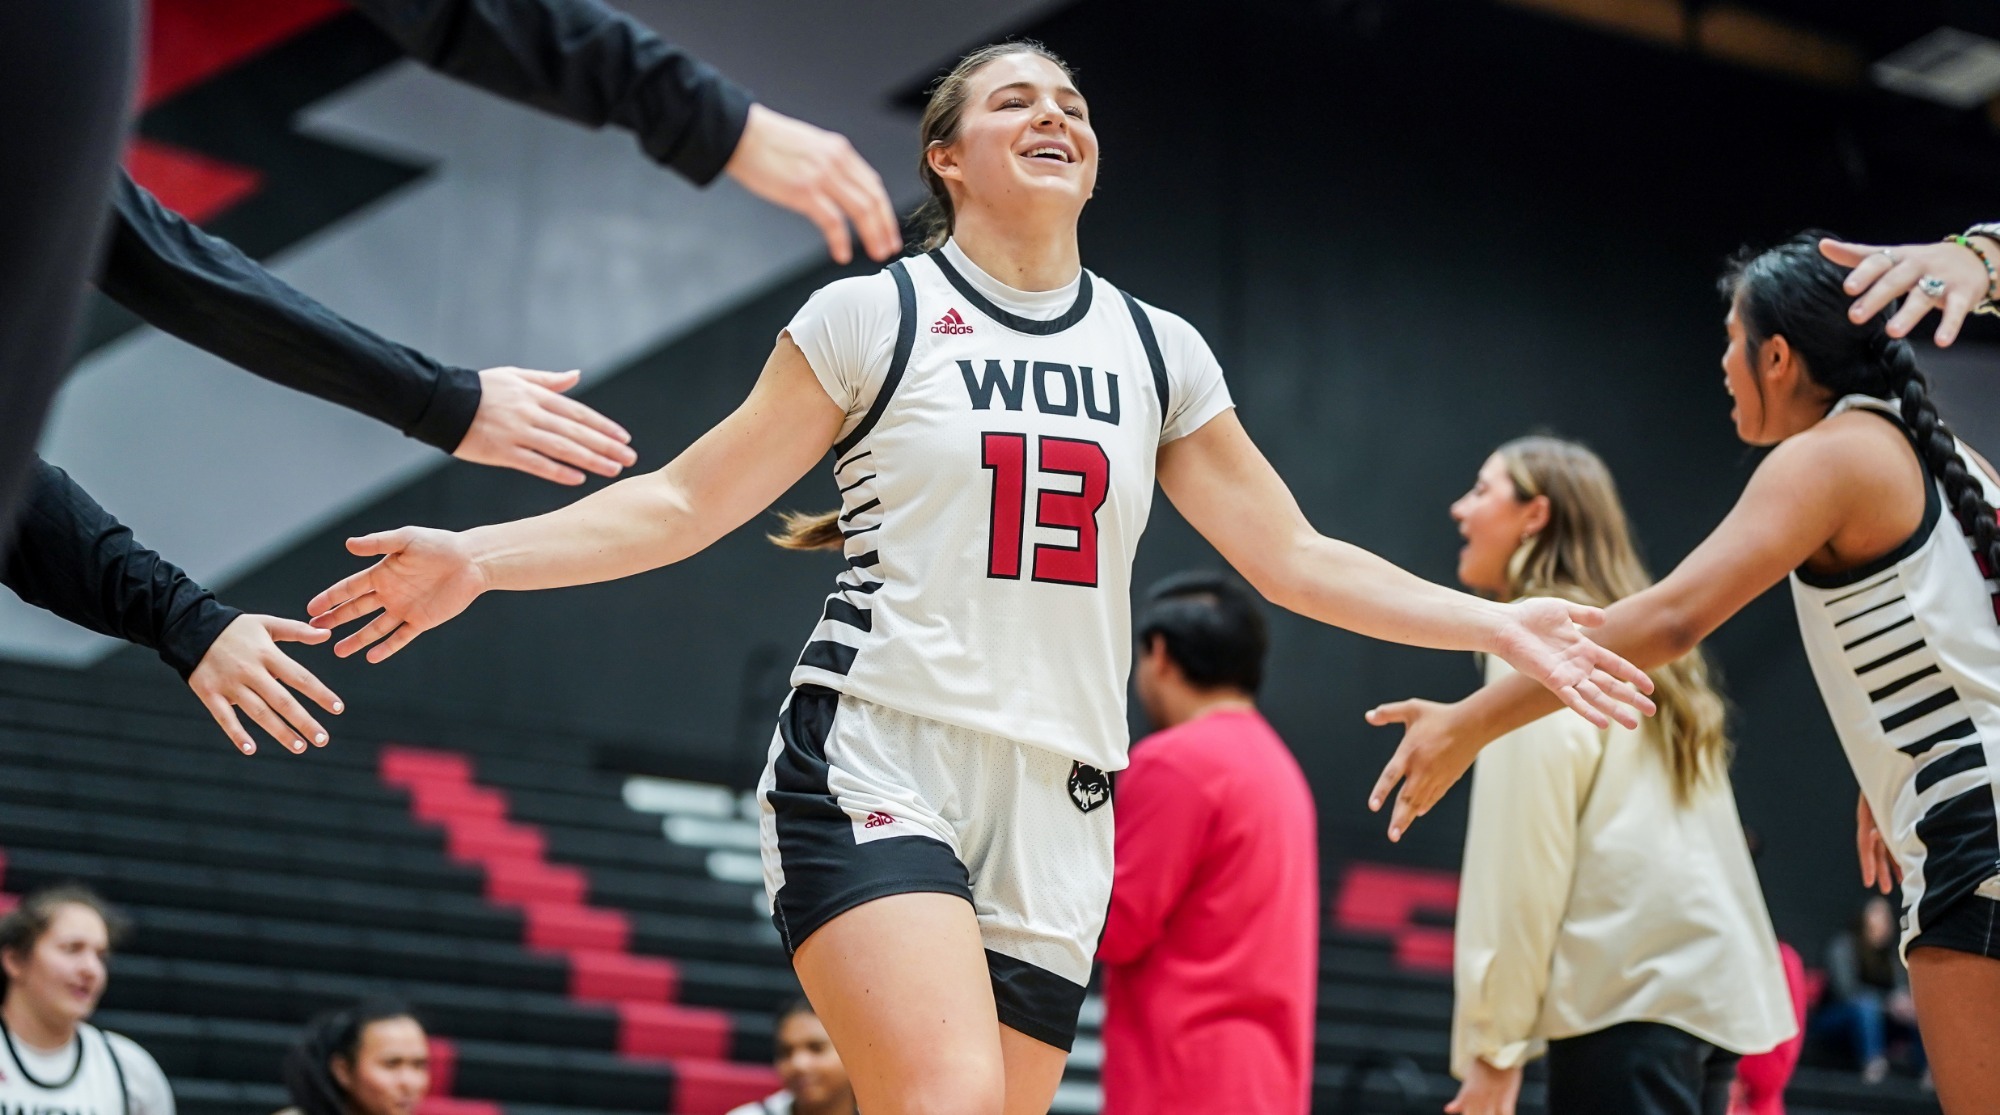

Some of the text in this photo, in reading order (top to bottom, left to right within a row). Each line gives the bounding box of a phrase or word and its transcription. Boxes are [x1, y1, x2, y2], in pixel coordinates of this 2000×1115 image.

[931, 323, 974, 335] adidas
[955, 359, 1121, 426] WOU
[981, 431, 1110, 588] 13
